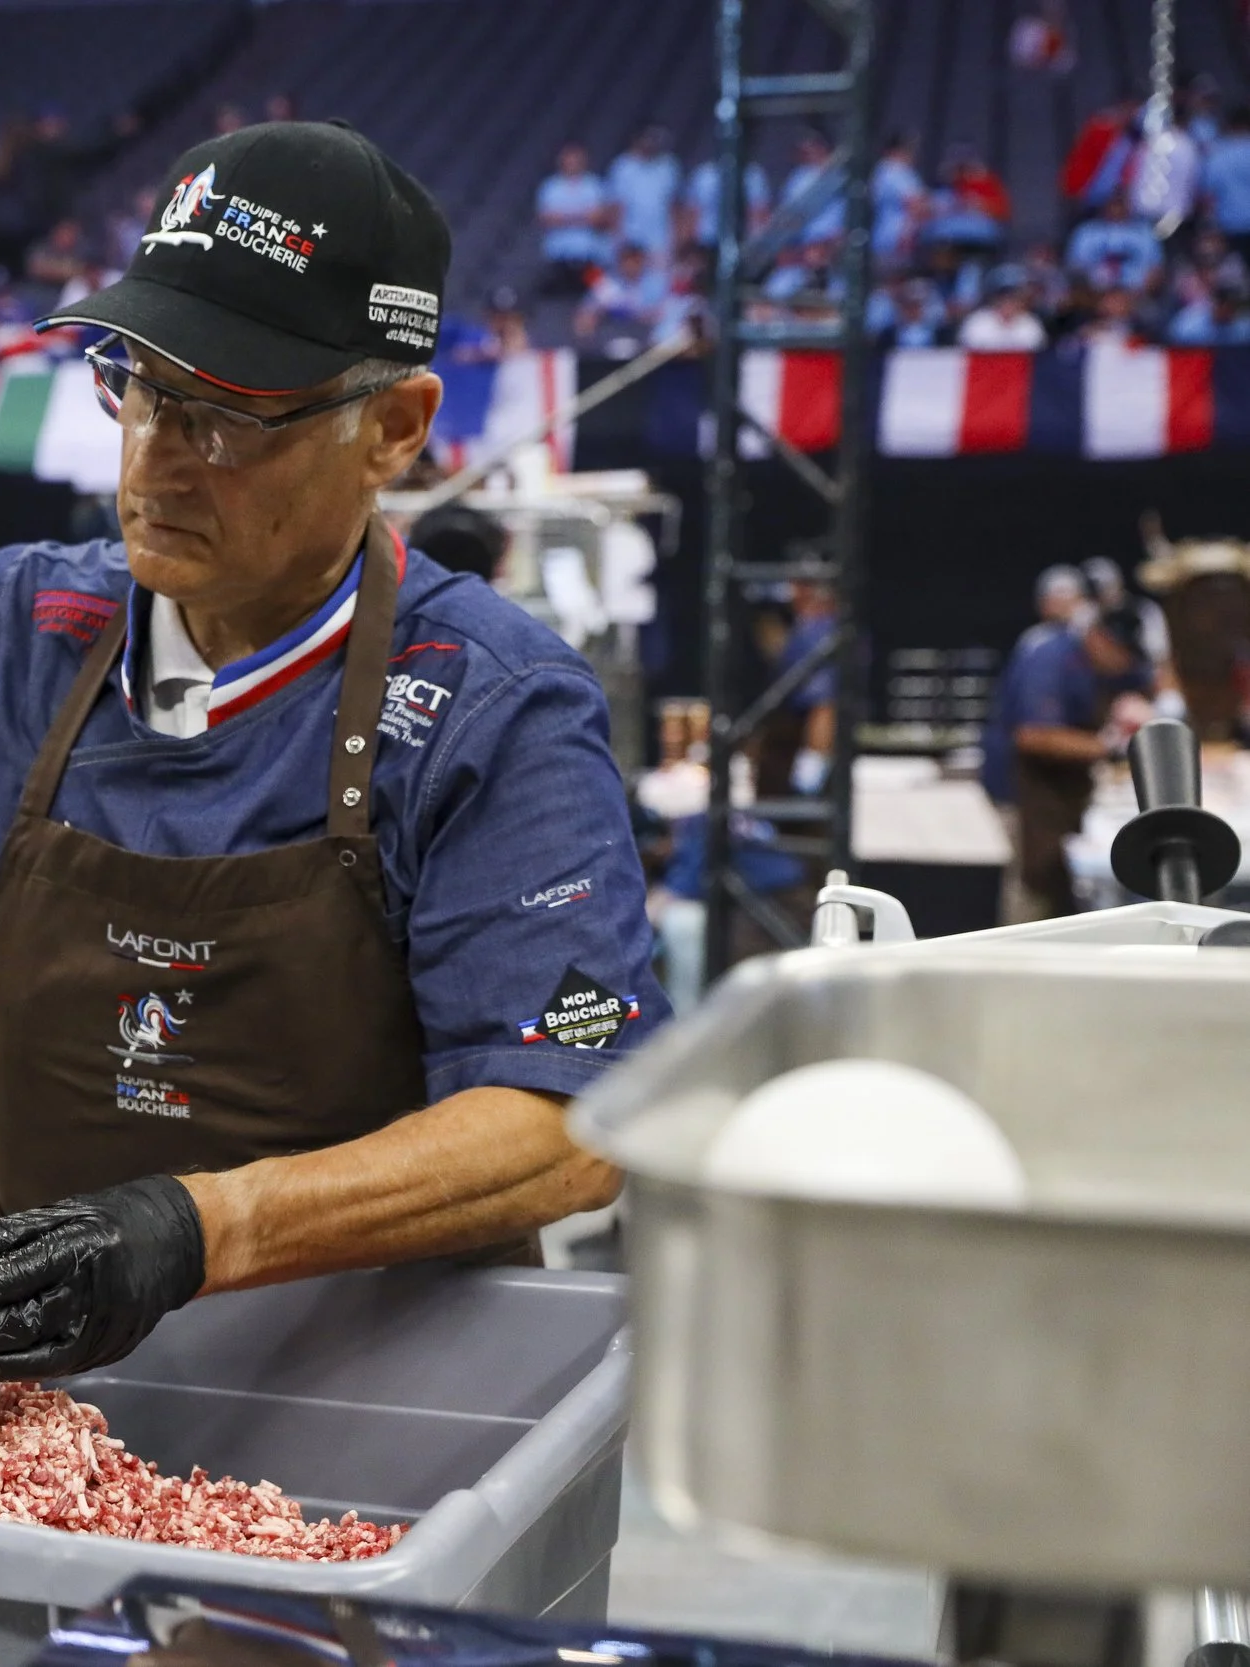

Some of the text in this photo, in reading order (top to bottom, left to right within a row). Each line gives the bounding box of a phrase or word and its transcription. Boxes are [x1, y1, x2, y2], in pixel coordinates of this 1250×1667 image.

[229, 195, 302, 235] EQUIPE de
[215, 219, 310, 274] BOUCHERIE
[222, 207, 315, 257] FRANCE
[368, 305, 389, 323] UN
[521, 878, 592, 907] LAFONT
[106, 923, 218, 961] LAFONT
[561, 990, 598, 1009] MON
[116, 1083, 190, 1104] FRANCE
[116, 1096, 191, 1119] BOUCHERIE
